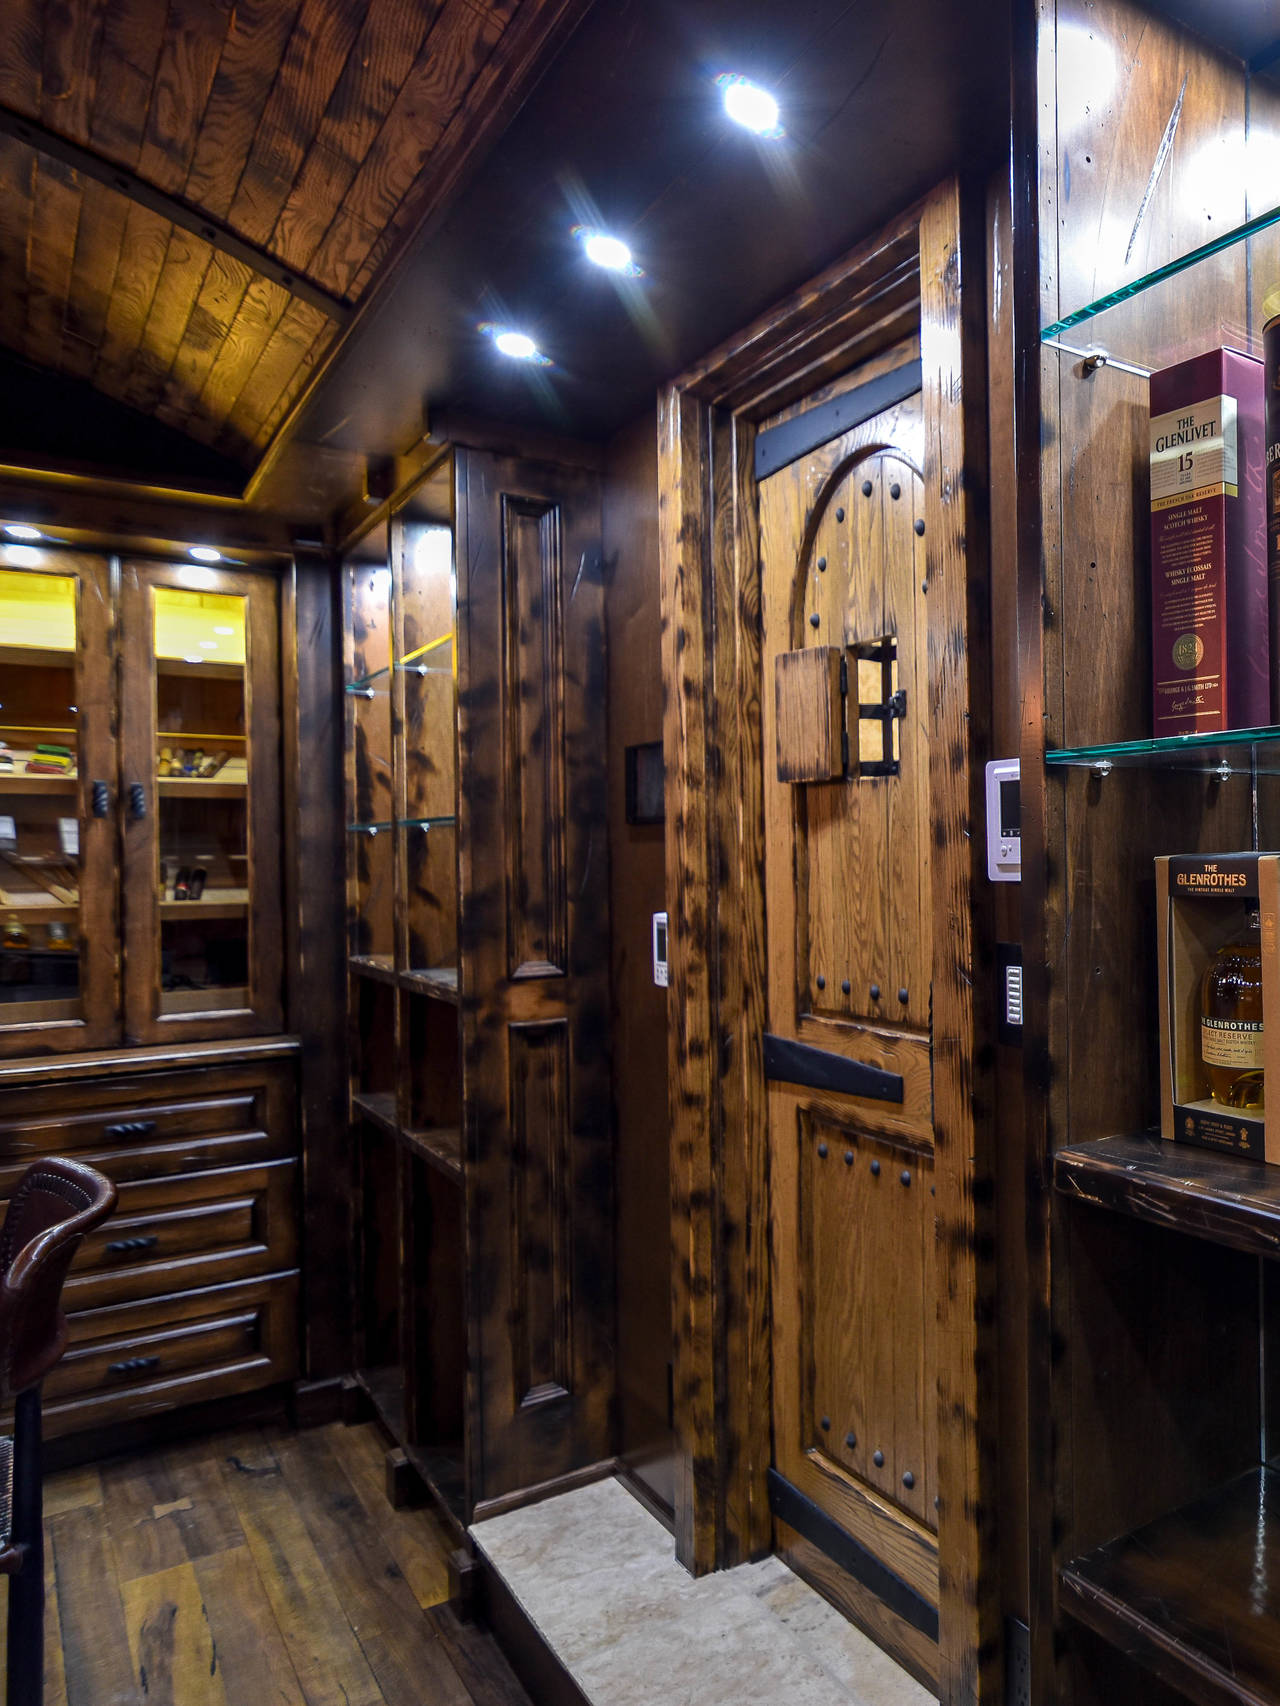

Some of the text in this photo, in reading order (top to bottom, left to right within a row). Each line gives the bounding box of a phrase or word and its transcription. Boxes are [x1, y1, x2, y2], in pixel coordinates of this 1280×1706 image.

[1177, 416, 1195, 430] THE
[1156, 421, 1216, 452] GLENLIVET
[1178, 451, 1194, 472] 15
[1204, 864, 1218, 872] THE
[1176, 873, 1247, 887] GLENROTHES
[1206, 1019, 1264, 1031] GLENROTHES
[1219, 1032, 1253, 1041] RESERVE
